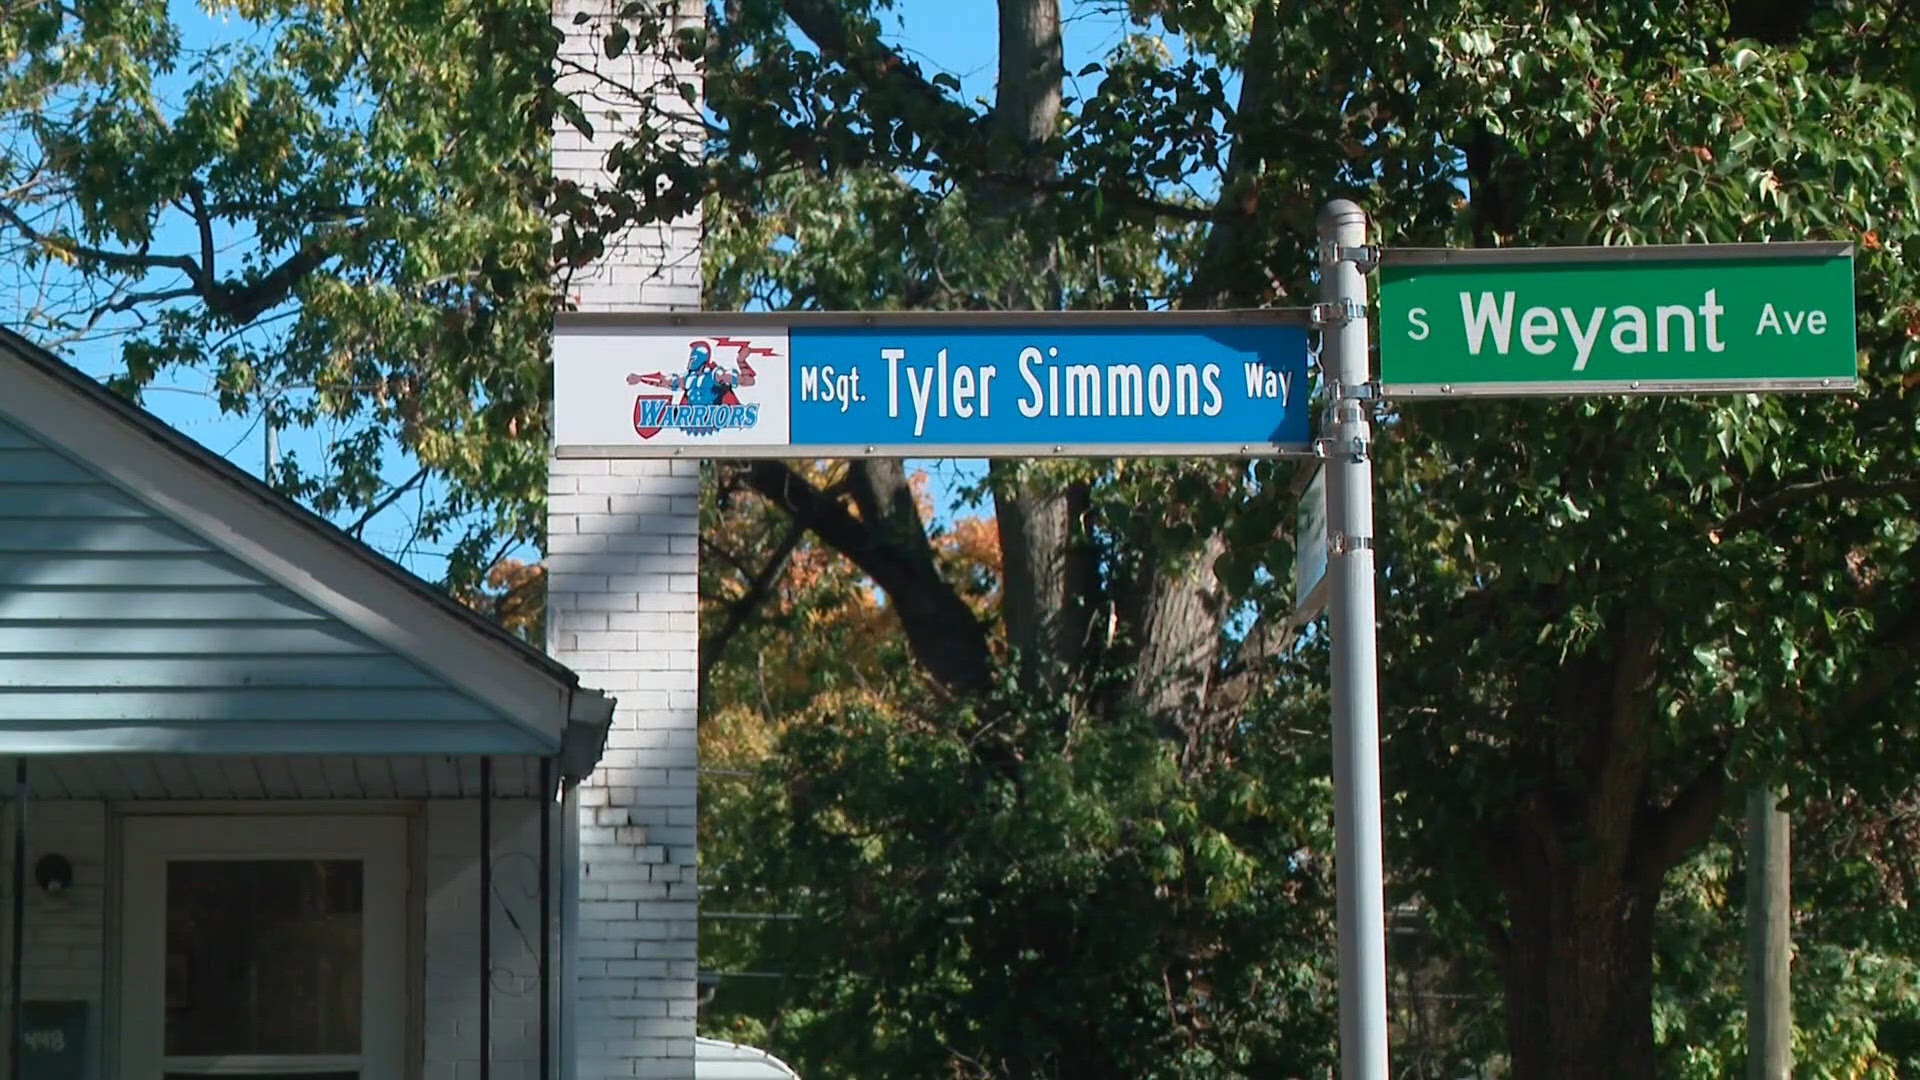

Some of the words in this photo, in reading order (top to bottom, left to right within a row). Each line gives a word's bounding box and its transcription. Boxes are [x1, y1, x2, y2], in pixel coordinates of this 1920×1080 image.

[1407, 307, 1430, 341] S
[1459, 288, 1725, 371] Weyant
[1756, 303, 1827, 336] Ave
[637, 398, 759, 429] WARRIORS
[801, 365, 866, 413] MSgt.
[881, 348, 996, 437] Tyler
[1017, 346, 1223, 418] Simmons
[1244, 362, 1292, 407] Way
